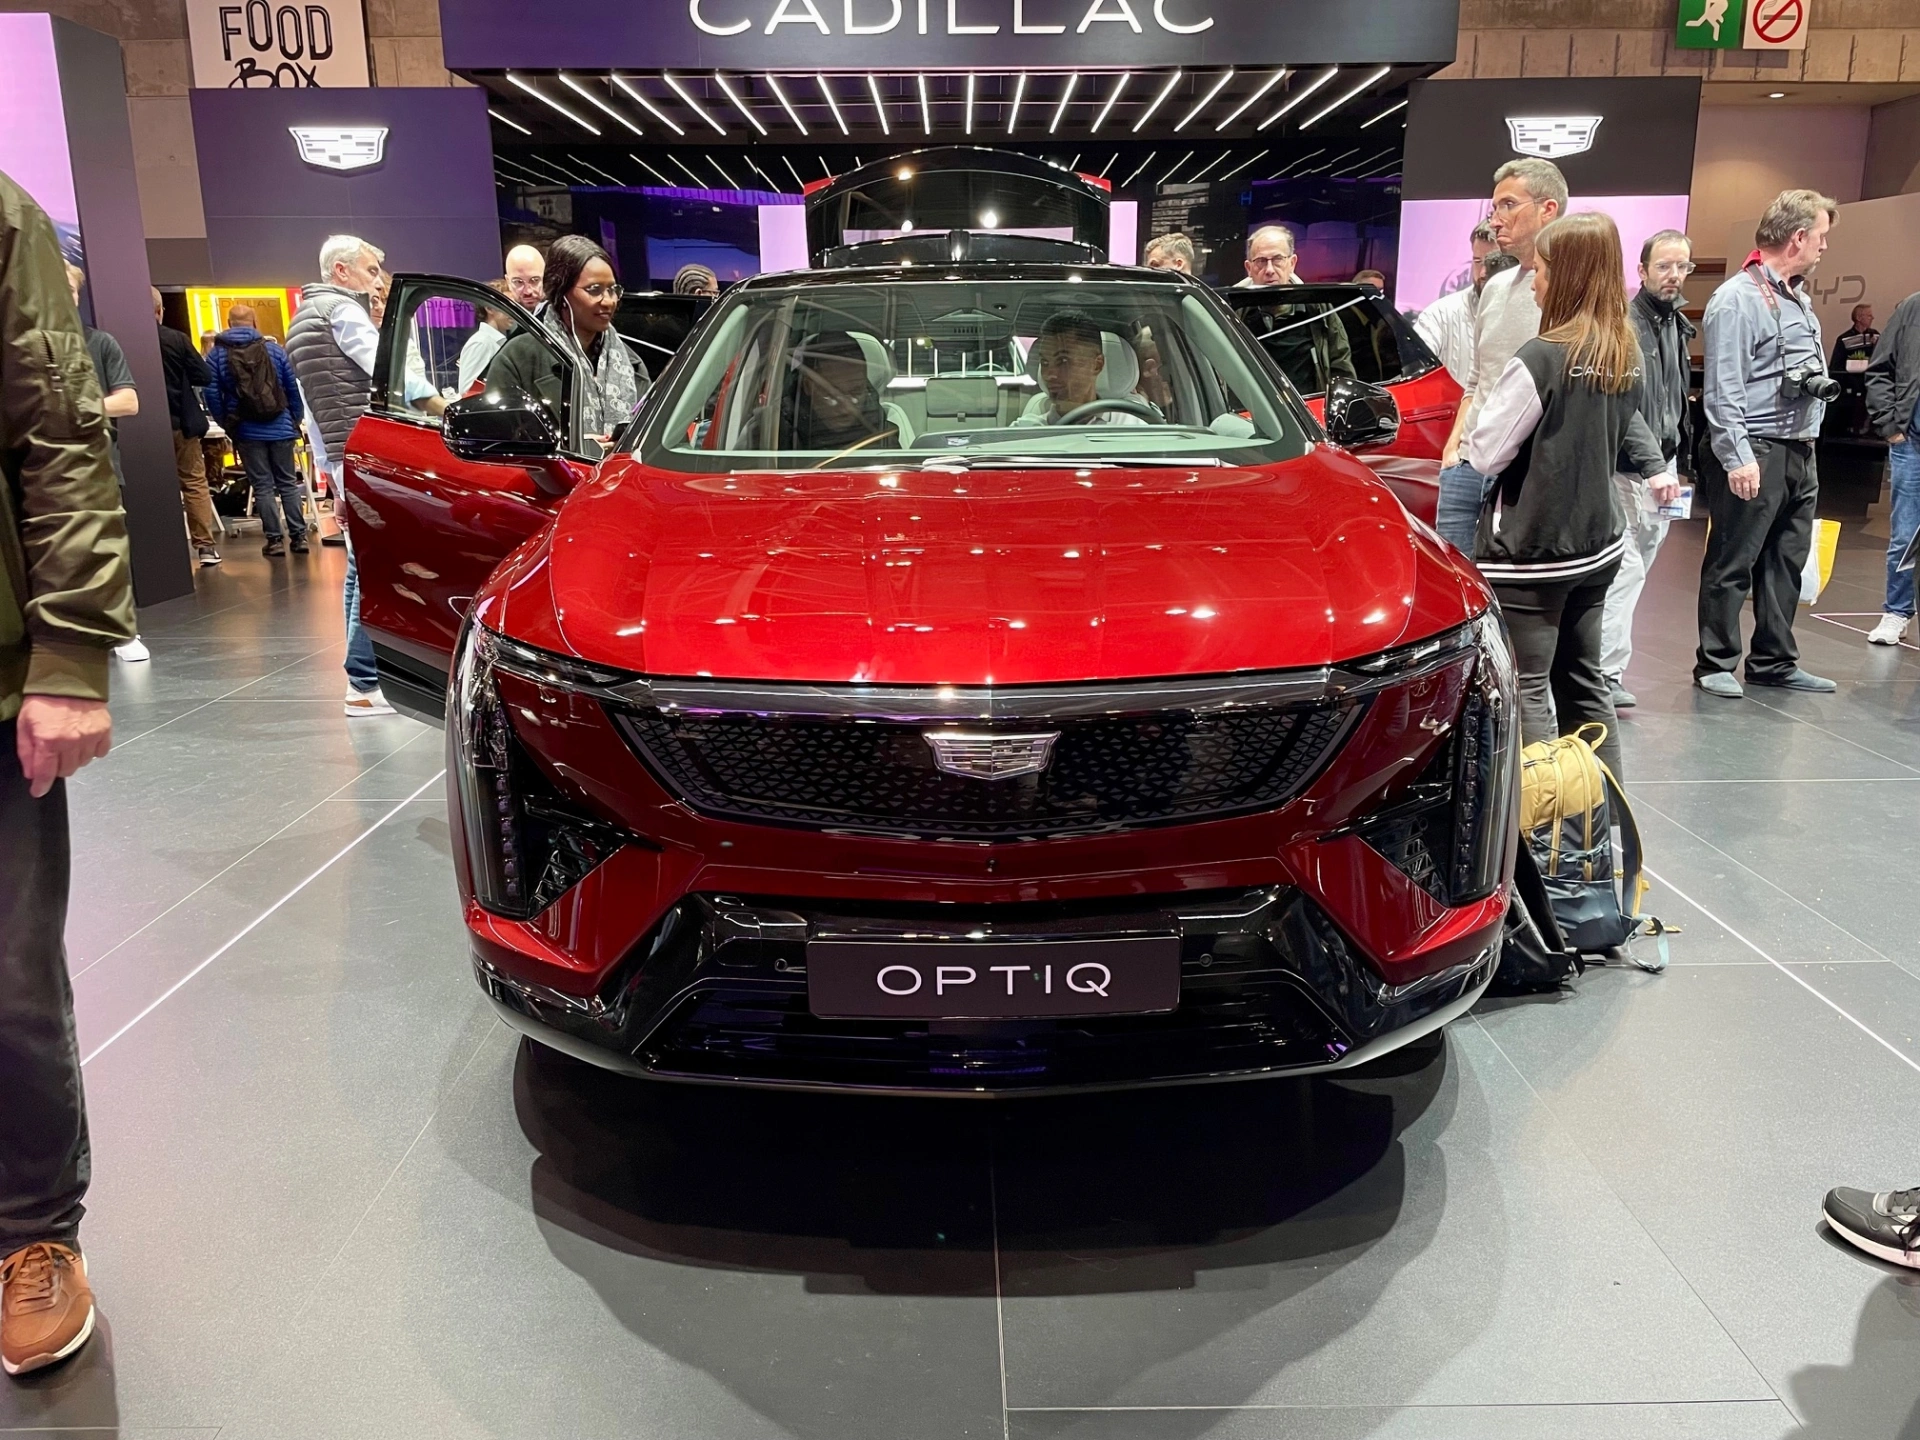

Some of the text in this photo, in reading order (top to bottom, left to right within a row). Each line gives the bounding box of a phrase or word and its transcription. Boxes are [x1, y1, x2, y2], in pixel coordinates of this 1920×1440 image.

[219, 0, 333, 61] FOOD
[689, 0, 1214, 36] CADILLAC
[876, 962, 1112, 997] OPTIQ
